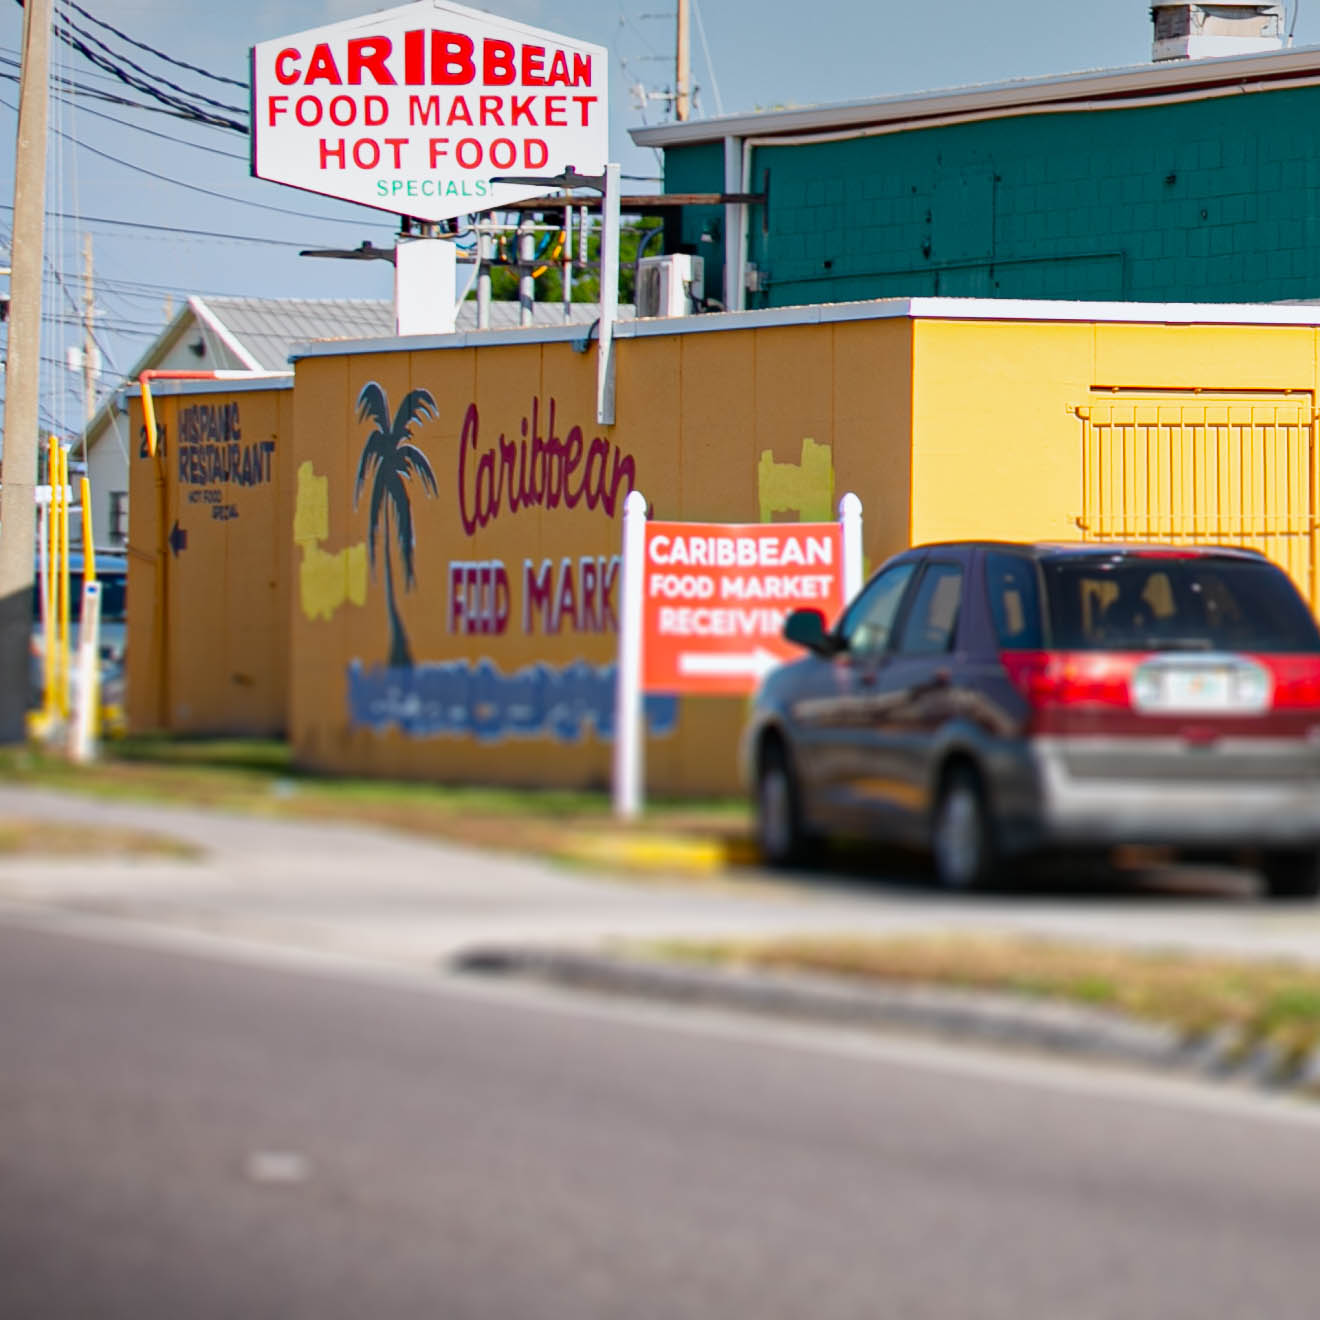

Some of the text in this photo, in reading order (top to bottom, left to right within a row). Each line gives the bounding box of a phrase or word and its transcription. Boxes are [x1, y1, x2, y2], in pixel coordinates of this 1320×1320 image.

[274, 28, 592, 87] CARIBBEAN
[268, 94, 598, 127] FOOD MARKET
[319, 138, 548, 170] HOT FOOD
[178, 440, 275, 487] RESTAURANT
[458, 395, 636, 537] Caribbean
[649, 535, 832, 566] CARIBBEAN
[448, 554, 624, 637] FOOD MARK
[649, 574, 834, 599] FOOD MARKET
[659, 606, 790, 636] RECEIVIN
